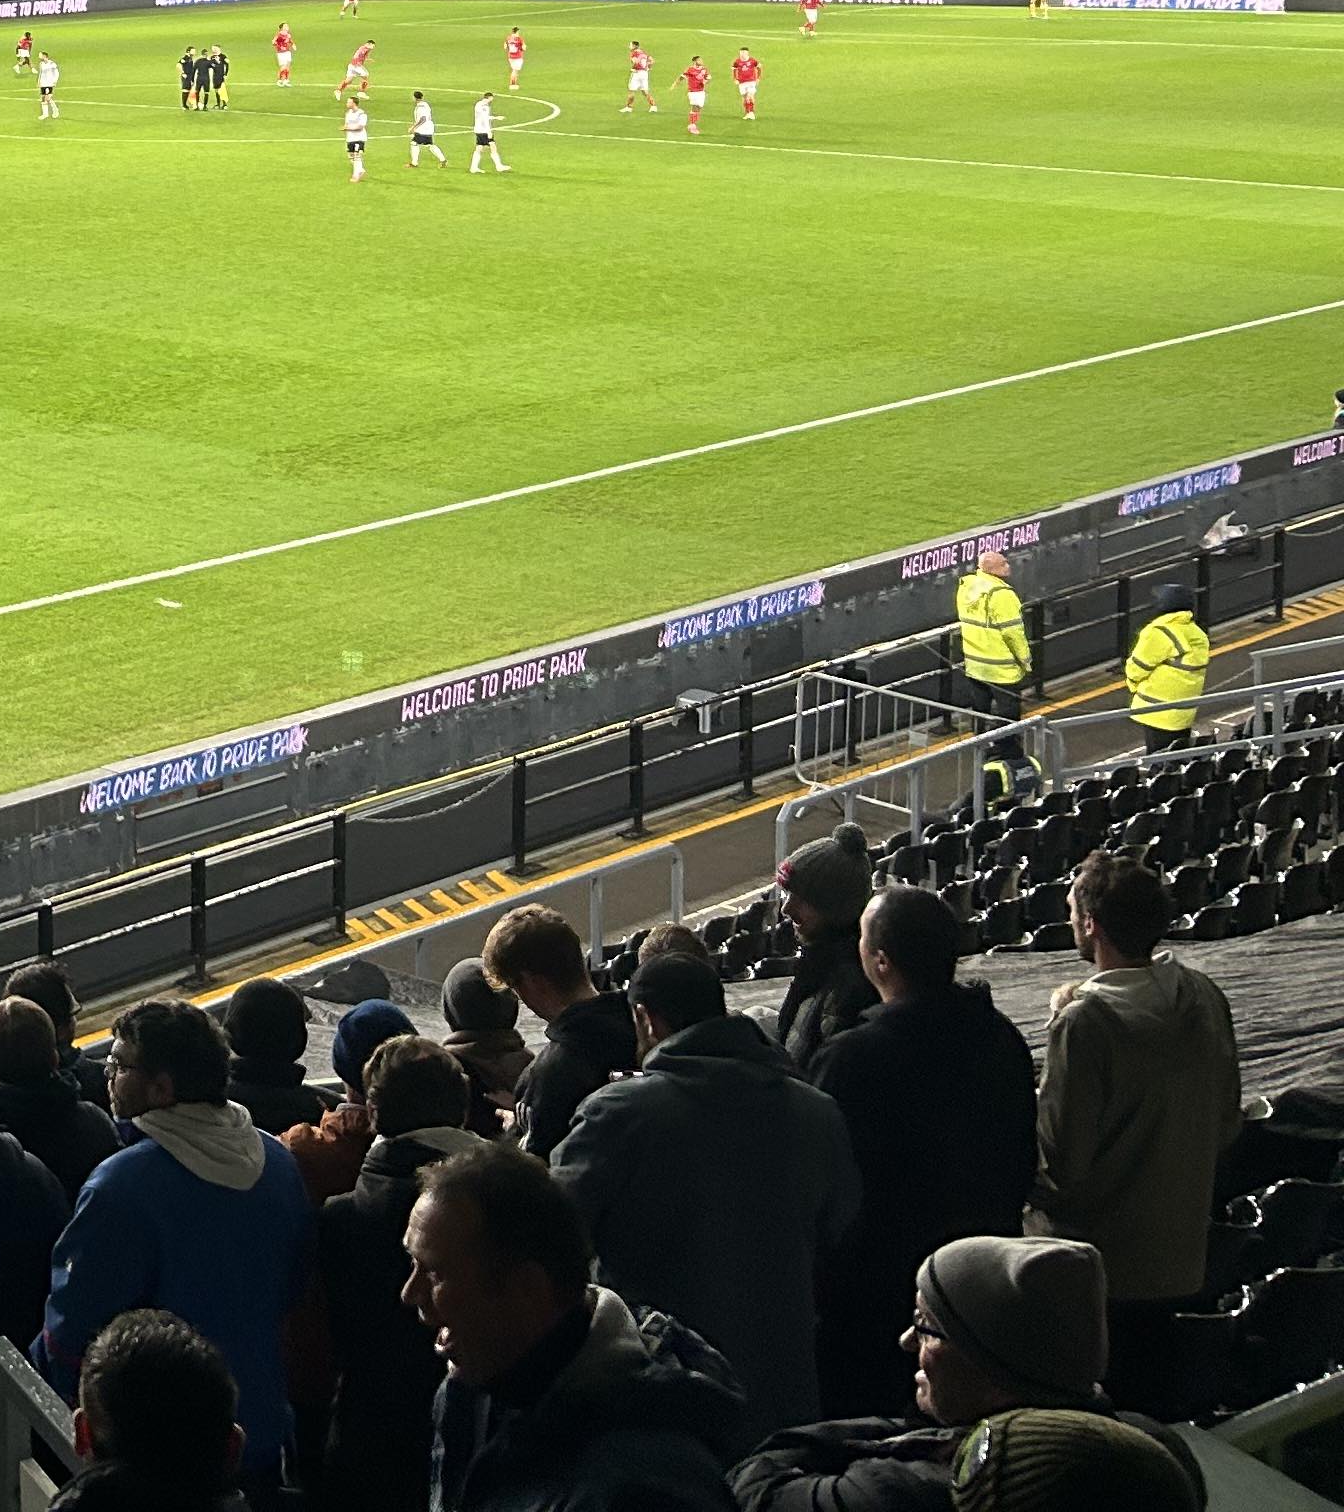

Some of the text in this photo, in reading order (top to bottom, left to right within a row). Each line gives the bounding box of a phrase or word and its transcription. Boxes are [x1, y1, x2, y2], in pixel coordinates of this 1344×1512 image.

[19, 1, 32, 16] TO
[32, 0, 62, 15] PRIDE
[1293, 438, 1338, 466] WELCOME
[902, 521, 1041, 579] WELCOME TO PRIDE PARK
[657, 581, 825, 647] WELCOME BACK TO PRIDE PARK
[401, 648, 587, 722] WELCOME TO PRIDE PARK
[80, 723, 309, 814] WELCOME BACK TO PRIDE PARK
